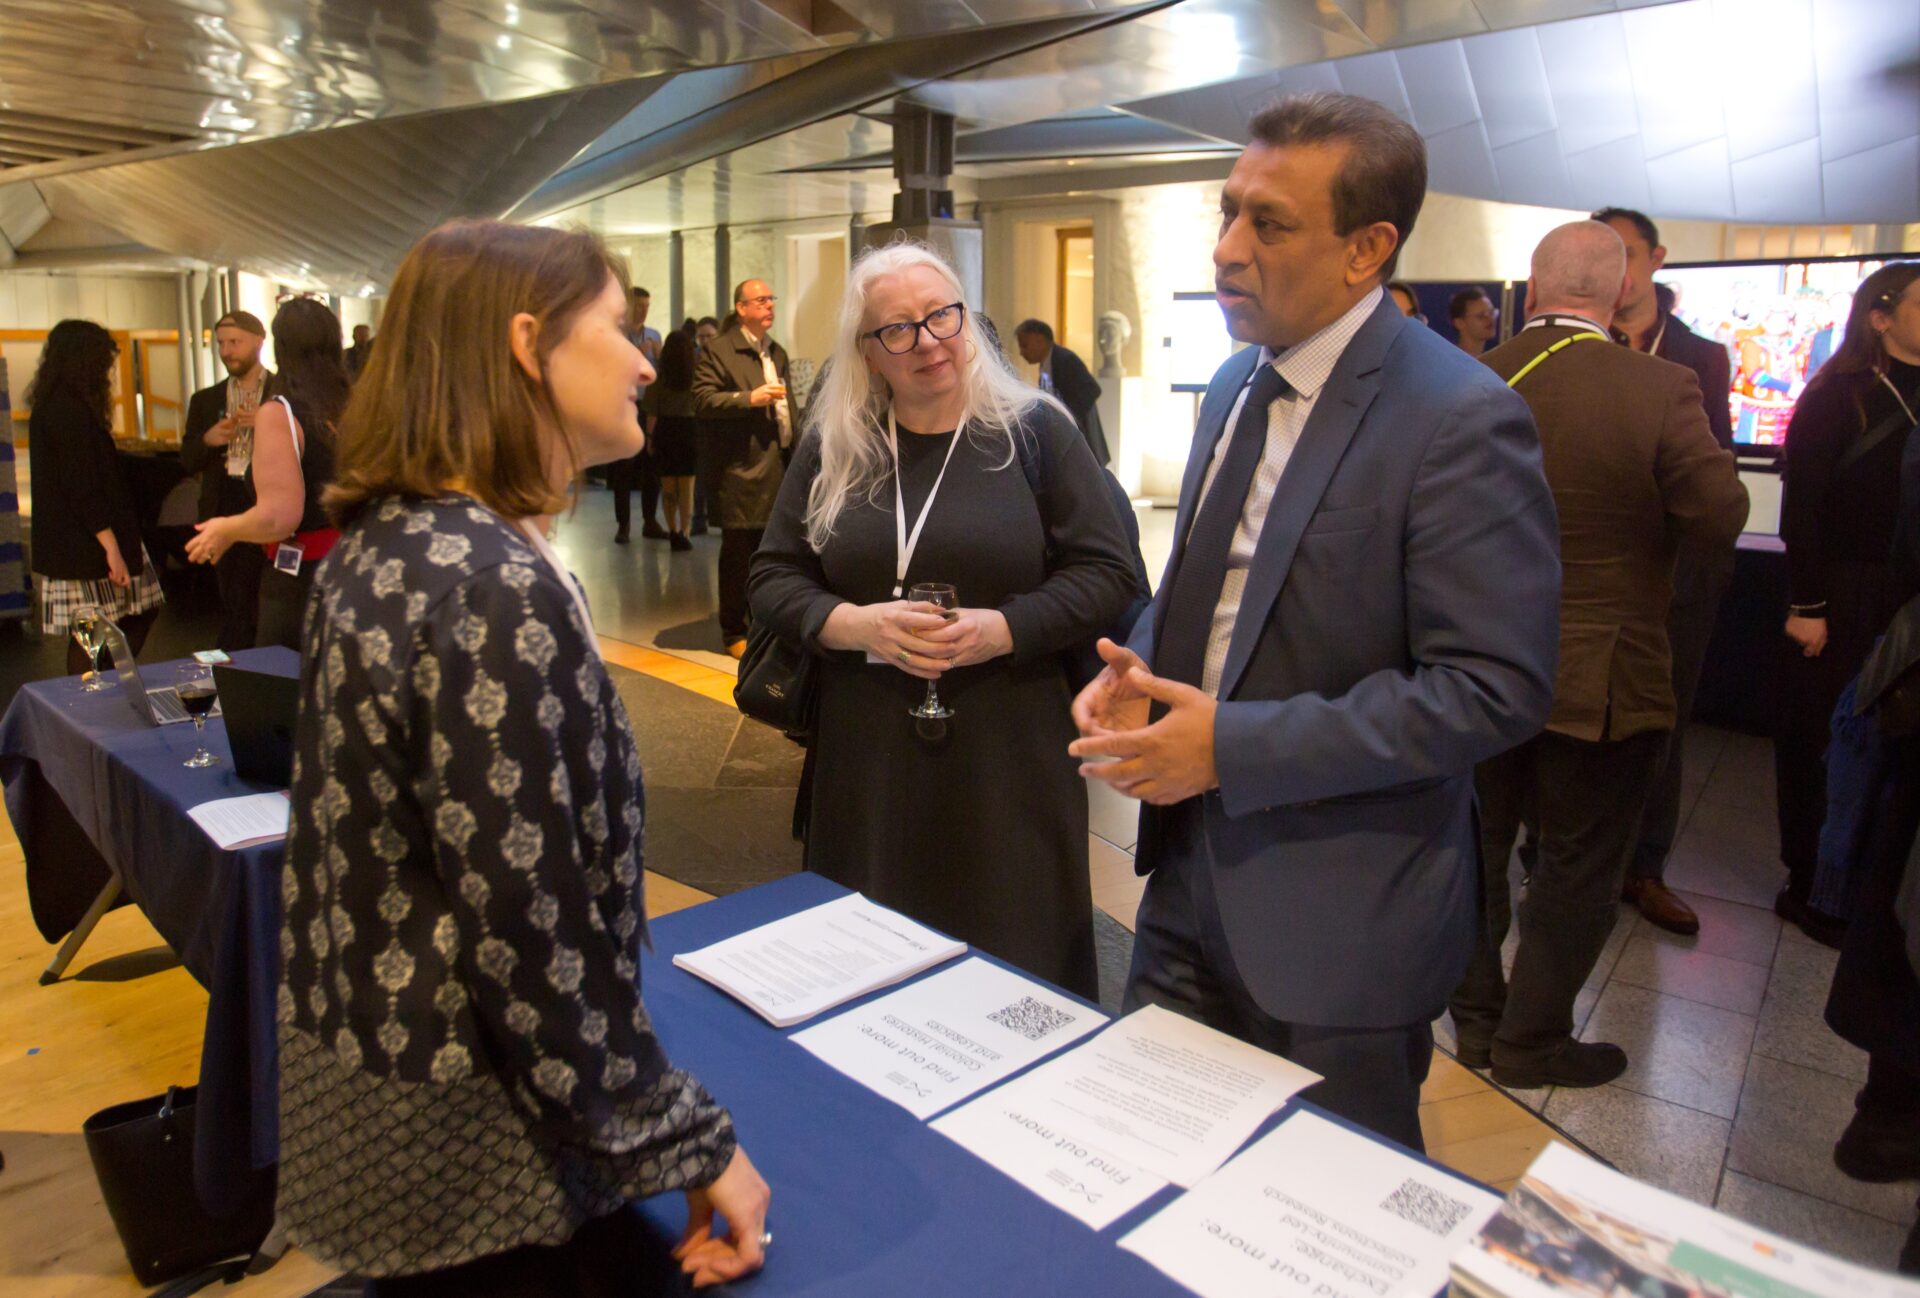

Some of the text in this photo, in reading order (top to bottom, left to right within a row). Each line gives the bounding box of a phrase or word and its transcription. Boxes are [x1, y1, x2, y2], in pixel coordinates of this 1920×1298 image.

[857, 1024, 900, 1050] more:
[881, 1014, 982, 1072] Colonial Histories
[925, 1019, 1002, 1062] and Legacies
[898, 1047, 926, 1064] out
[921, 1062, 960, 1084] Find
[1055, 1138, 1088, 1158] out
[1086, 1157, 1132, 1185] Find
[1200, 1218, 1311, 1285] out more:
